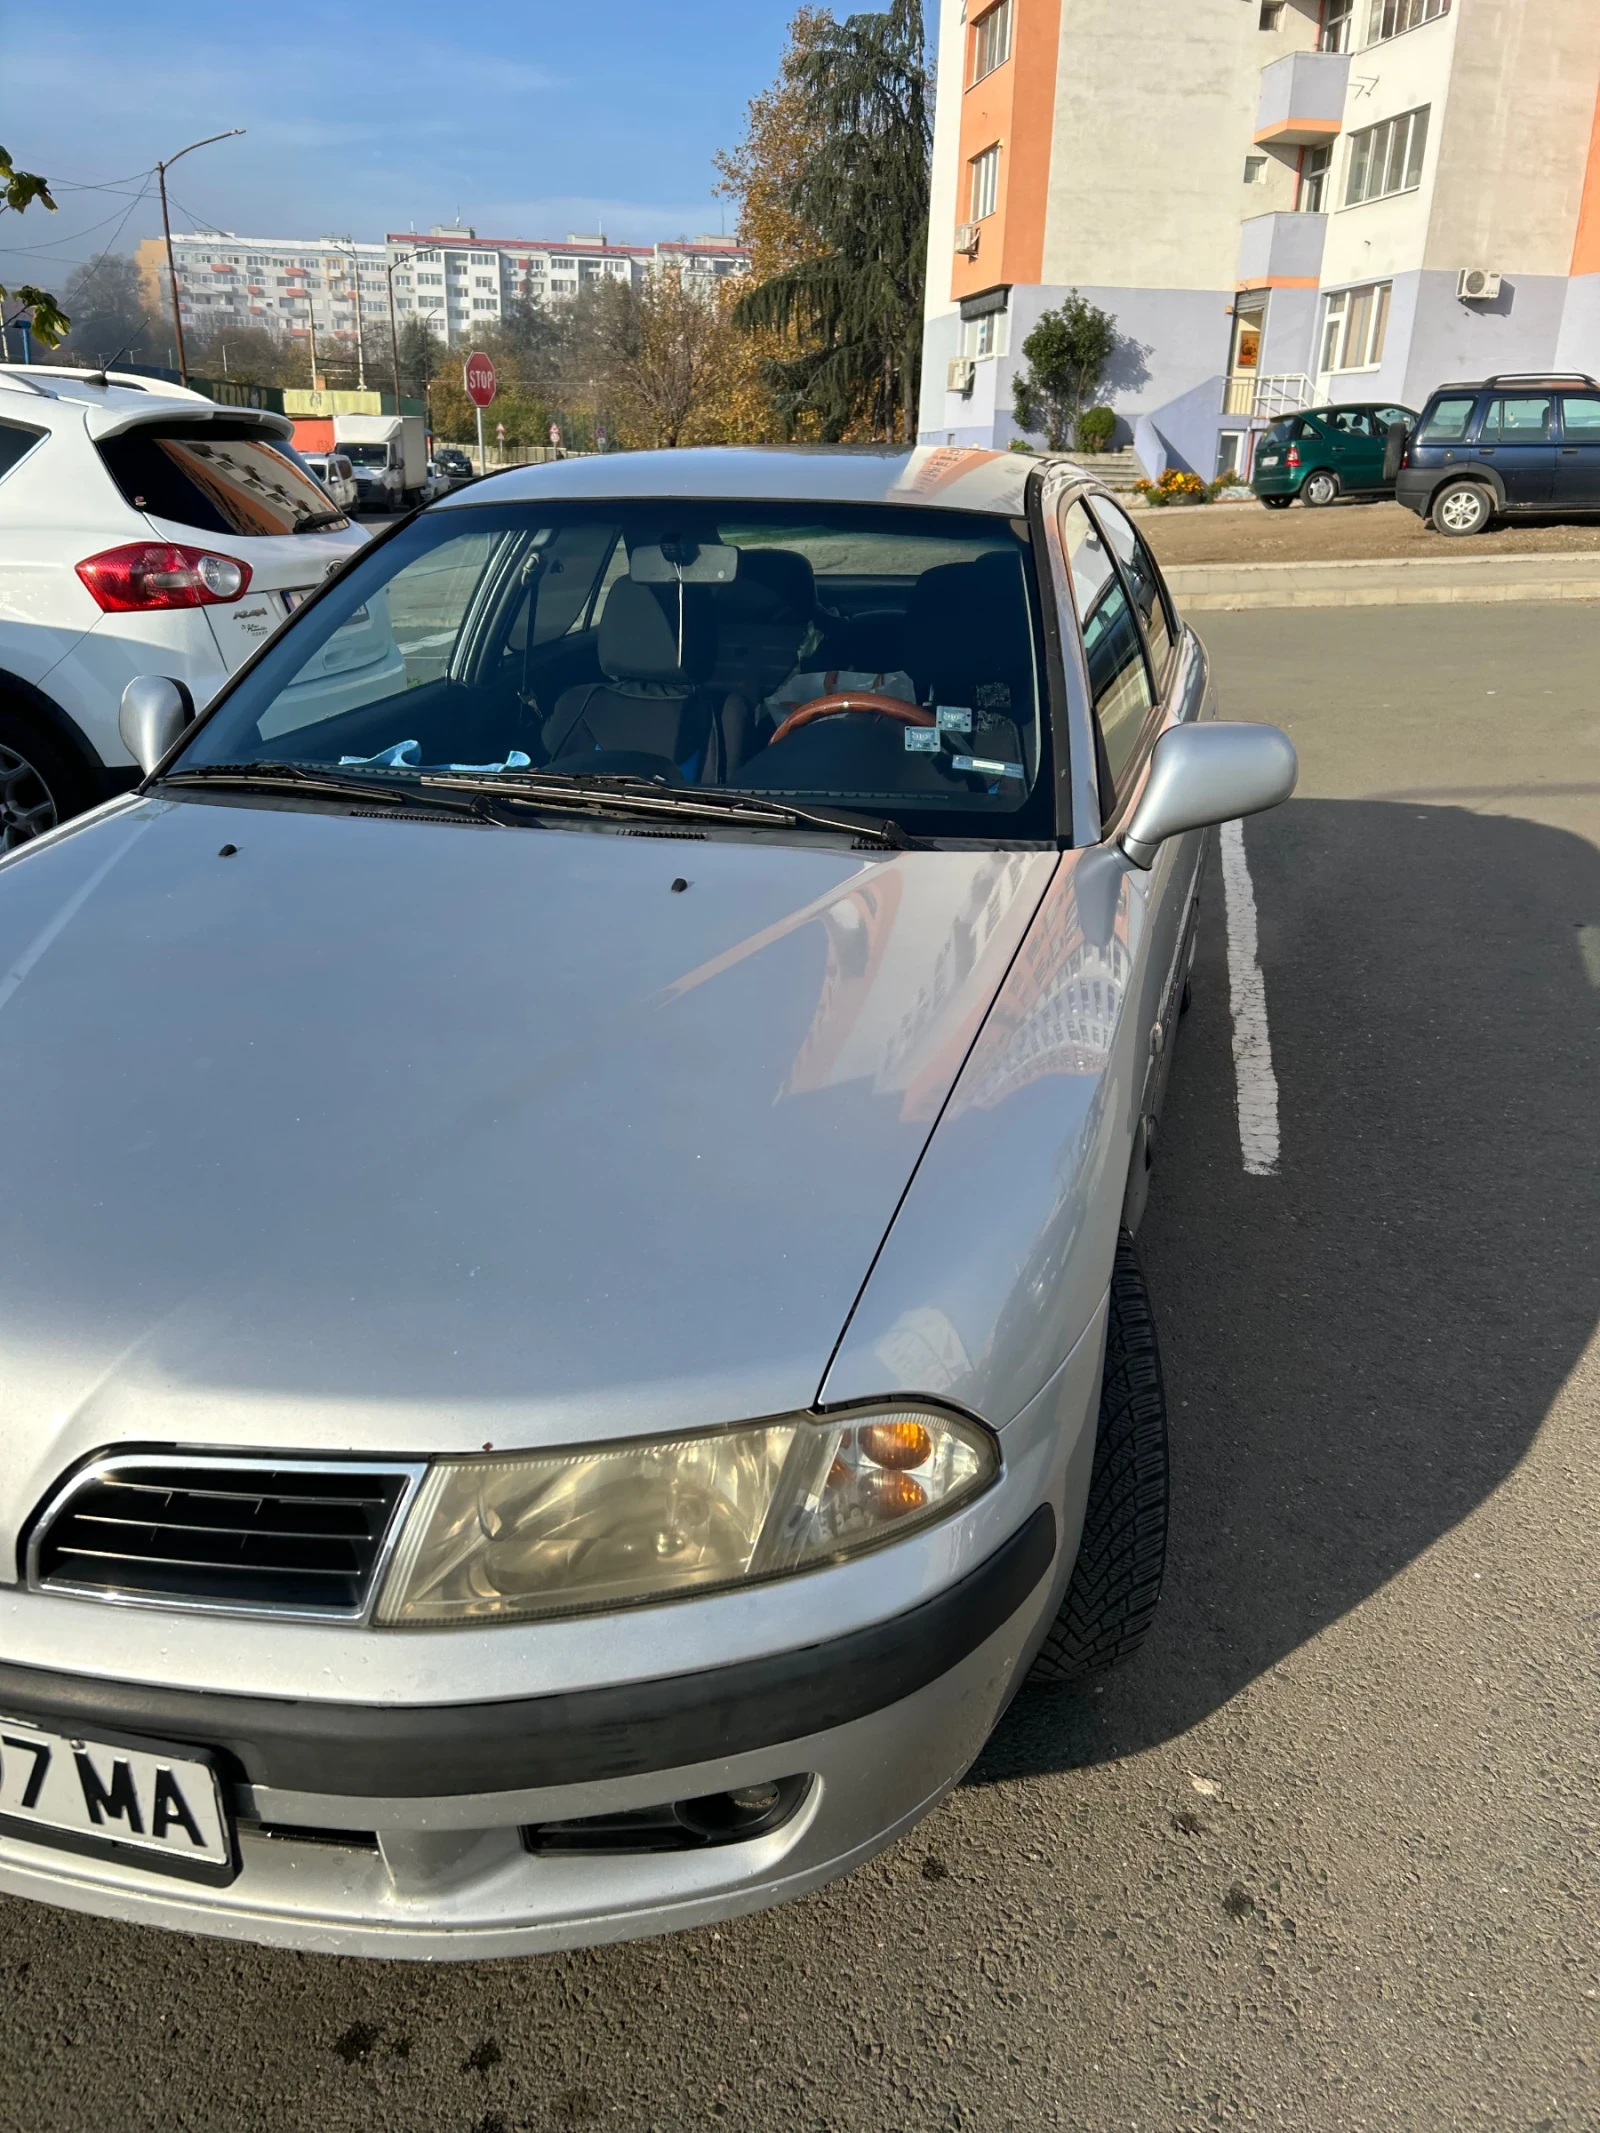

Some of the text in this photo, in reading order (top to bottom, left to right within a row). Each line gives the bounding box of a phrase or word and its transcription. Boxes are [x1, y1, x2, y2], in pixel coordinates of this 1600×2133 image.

[469, 370, 493, 389] STOP
[0, 1732, 208, 1848] 7 MA
